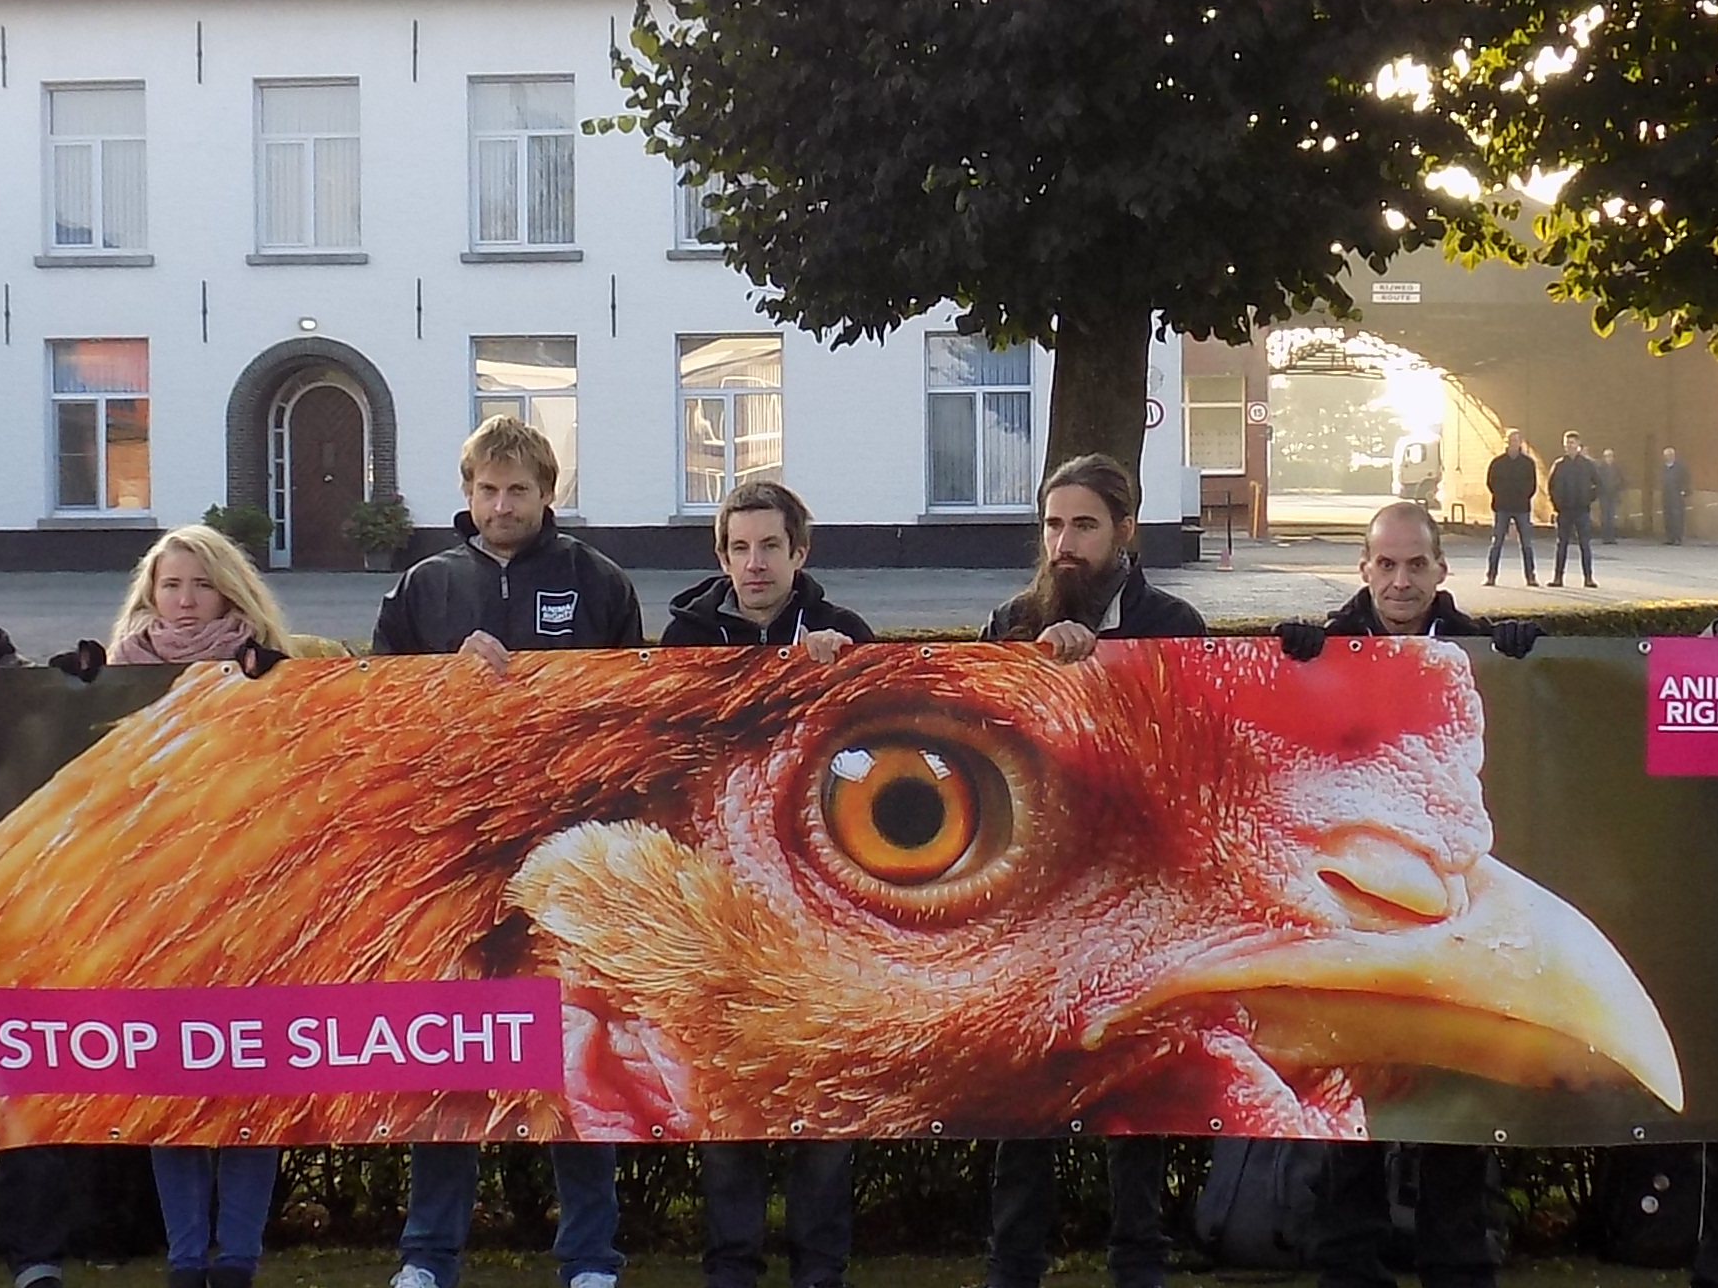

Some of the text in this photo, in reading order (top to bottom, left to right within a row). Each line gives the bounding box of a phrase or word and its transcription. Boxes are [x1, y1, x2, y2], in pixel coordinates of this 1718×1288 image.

[1253, 408, 1263, 418] 15
[180, 1019, 267, 1070] DE
[287, 1013, 534, 1068] SLACHT
